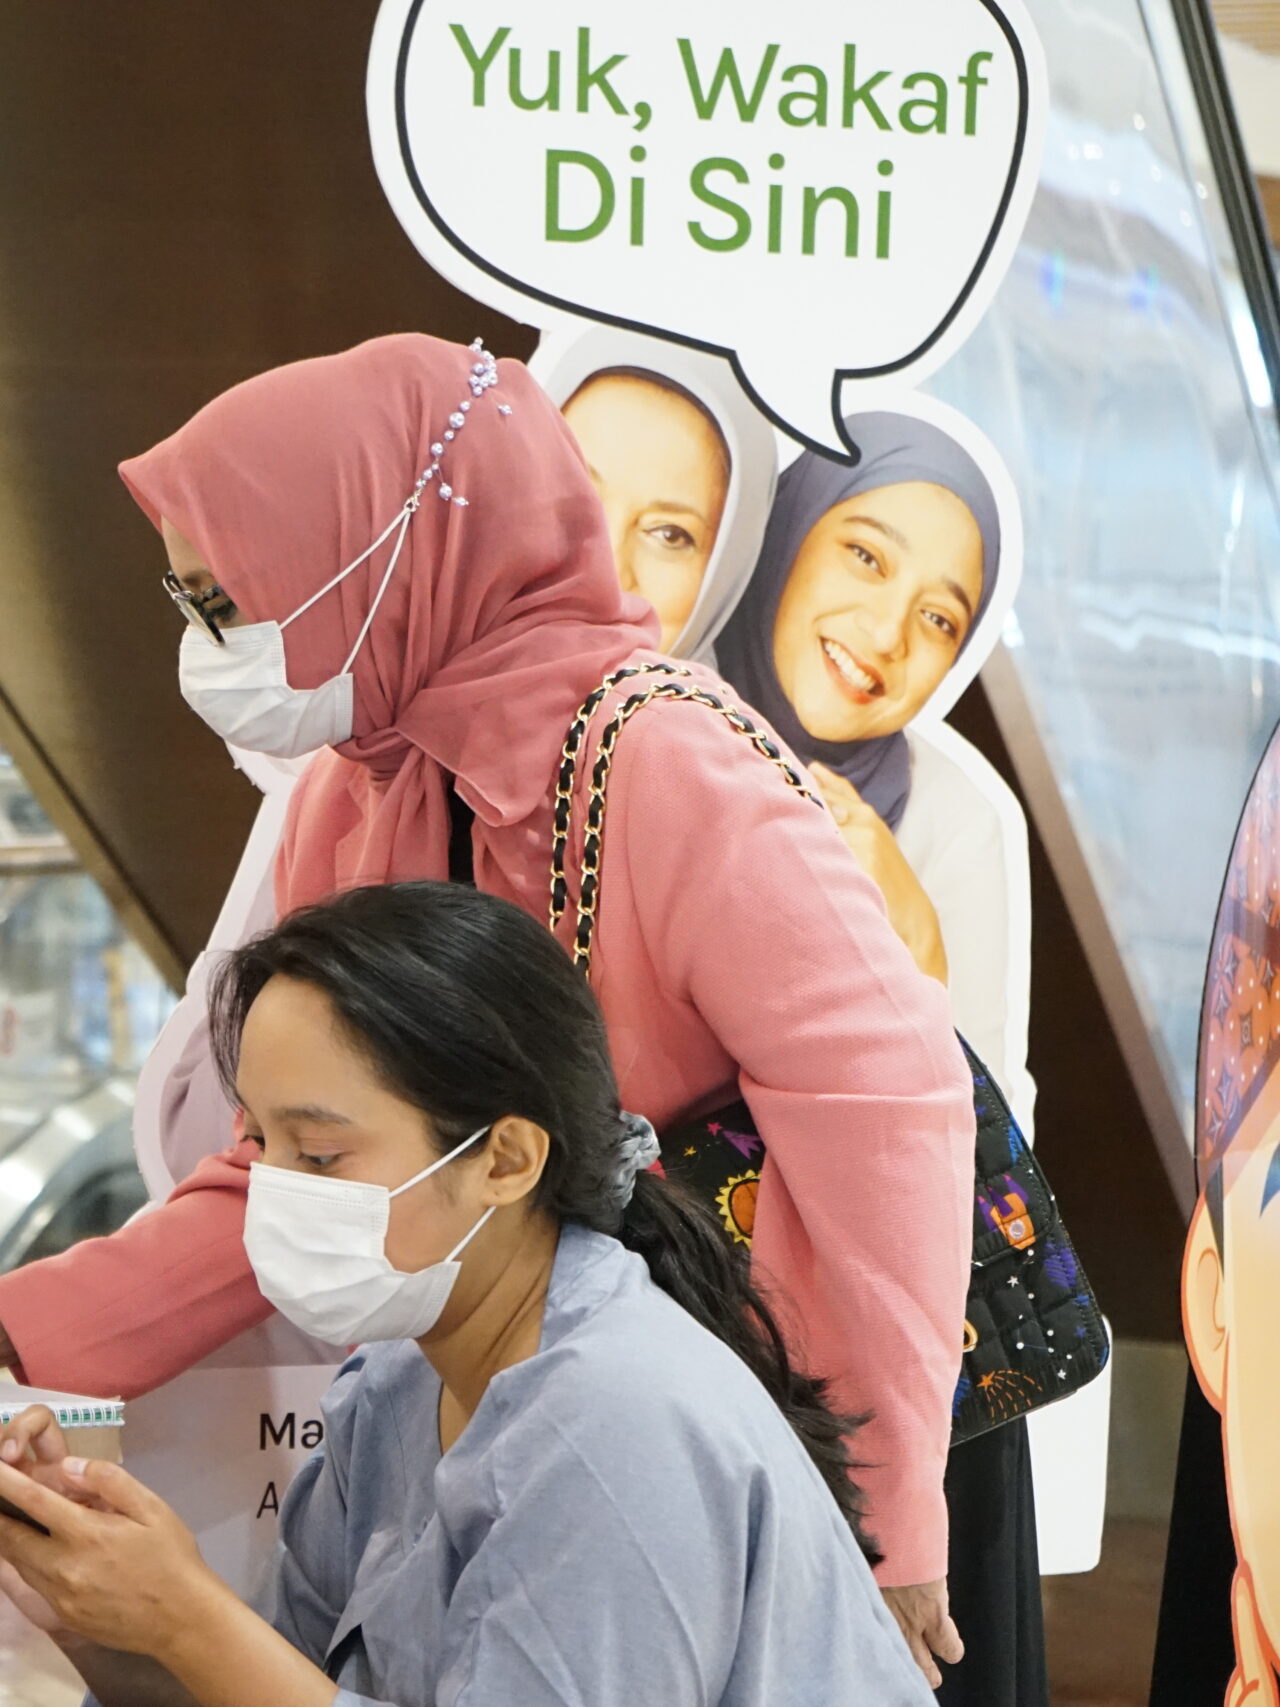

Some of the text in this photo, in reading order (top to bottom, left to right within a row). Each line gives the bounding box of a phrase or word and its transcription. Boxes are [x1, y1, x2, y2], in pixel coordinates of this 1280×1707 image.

[448, 23, 994, 137] Yuk, Wakaf
[543, 145, 894, 259] Di Sini
